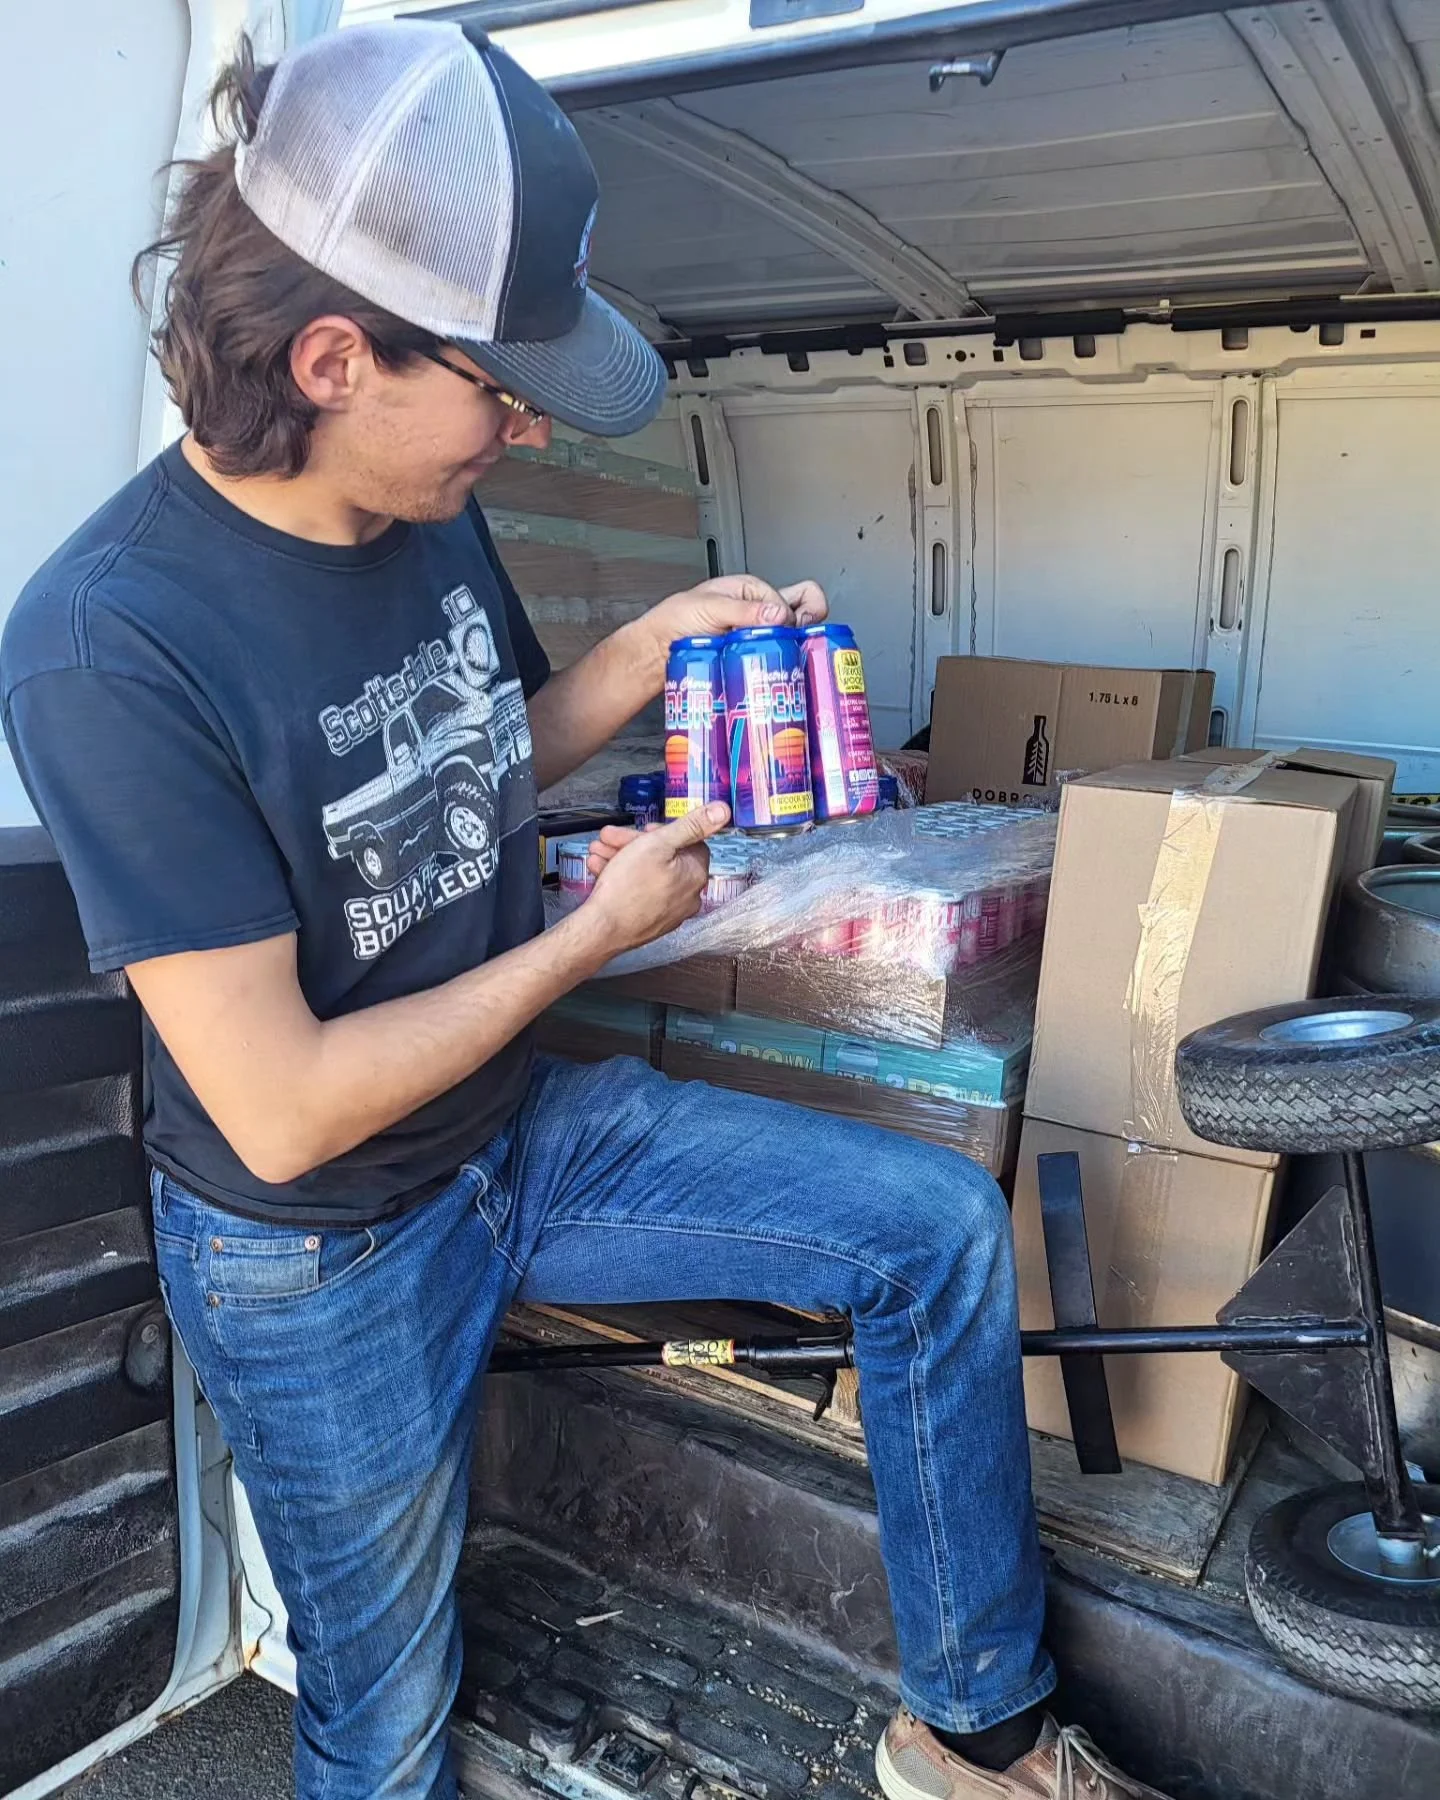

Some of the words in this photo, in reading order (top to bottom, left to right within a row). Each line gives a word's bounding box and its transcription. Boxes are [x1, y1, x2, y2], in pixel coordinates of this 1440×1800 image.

[442, 583, 480, 625] 10
[319, 638, 450, 756] Scottsdale
[665, 691, 714, 730] OUR
[750, 681, 806, 723] SOU
[1089, 691, 1111, 704] 1.75
[1113, 693, 1120, 705] L
[355, 893, 427, 957] BODY
[430, 845, 500, 904] LEGEN
